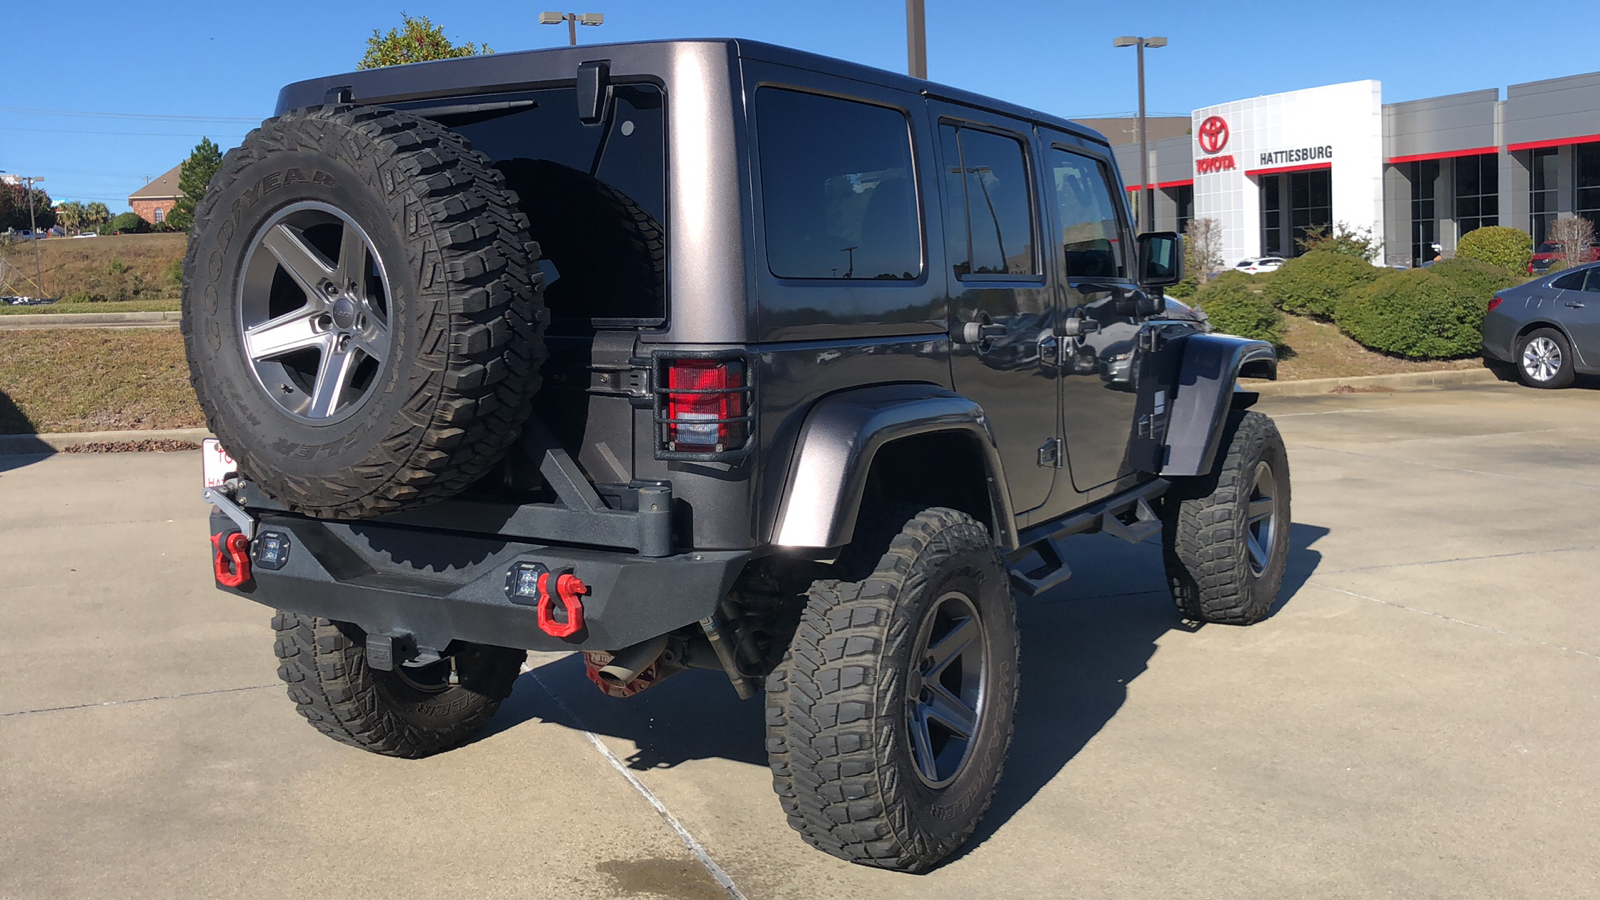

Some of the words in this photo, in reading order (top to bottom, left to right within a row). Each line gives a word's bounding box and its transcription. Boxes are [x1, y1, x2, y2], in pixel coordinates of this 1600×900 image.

[1195, 154, 1236, 174] TOYOTA
[1259, 145, 1332, 165] HATTIESBURG
[204, 167, 336, 351] GOODYEAR
[929, 661, 1009, 820] WRANGLER
